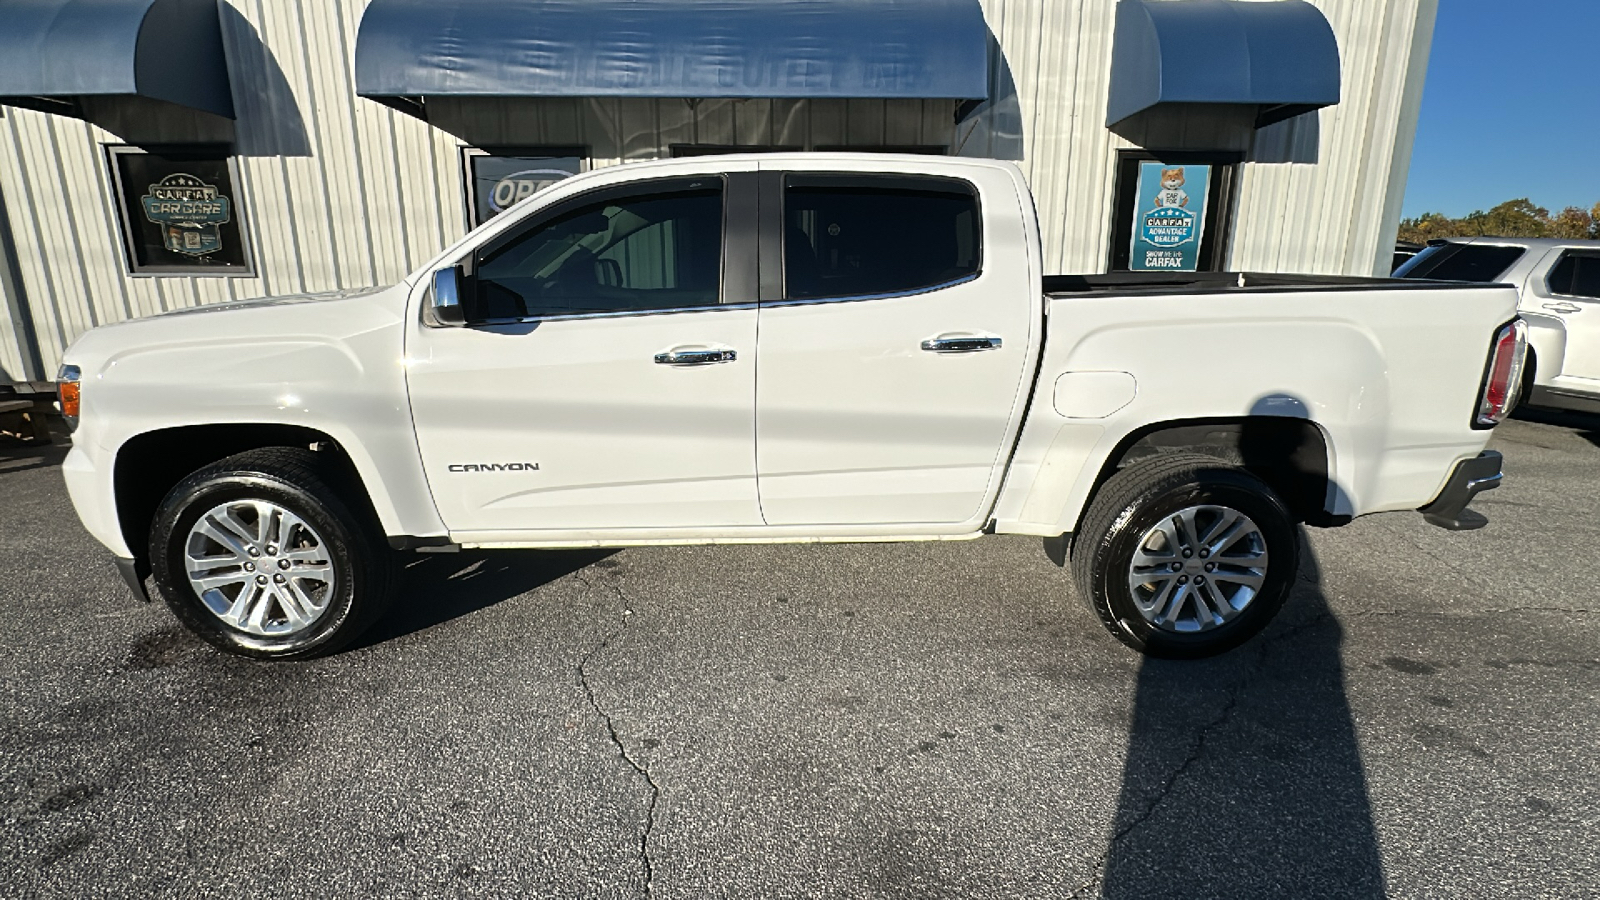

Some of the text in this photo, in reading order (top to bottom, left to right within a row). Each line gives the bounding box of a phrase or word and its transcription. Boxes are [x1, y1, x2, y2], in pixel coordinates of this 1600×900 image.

[156, 189, 213, 200] CARFAX
[151, 203, 221, 214] CAR CARE
[1147, 218, 1190, 227] CARFAX
[1145, 257, 1183, 268] CARFAX
[448, 462, 540, 472] CANYON
